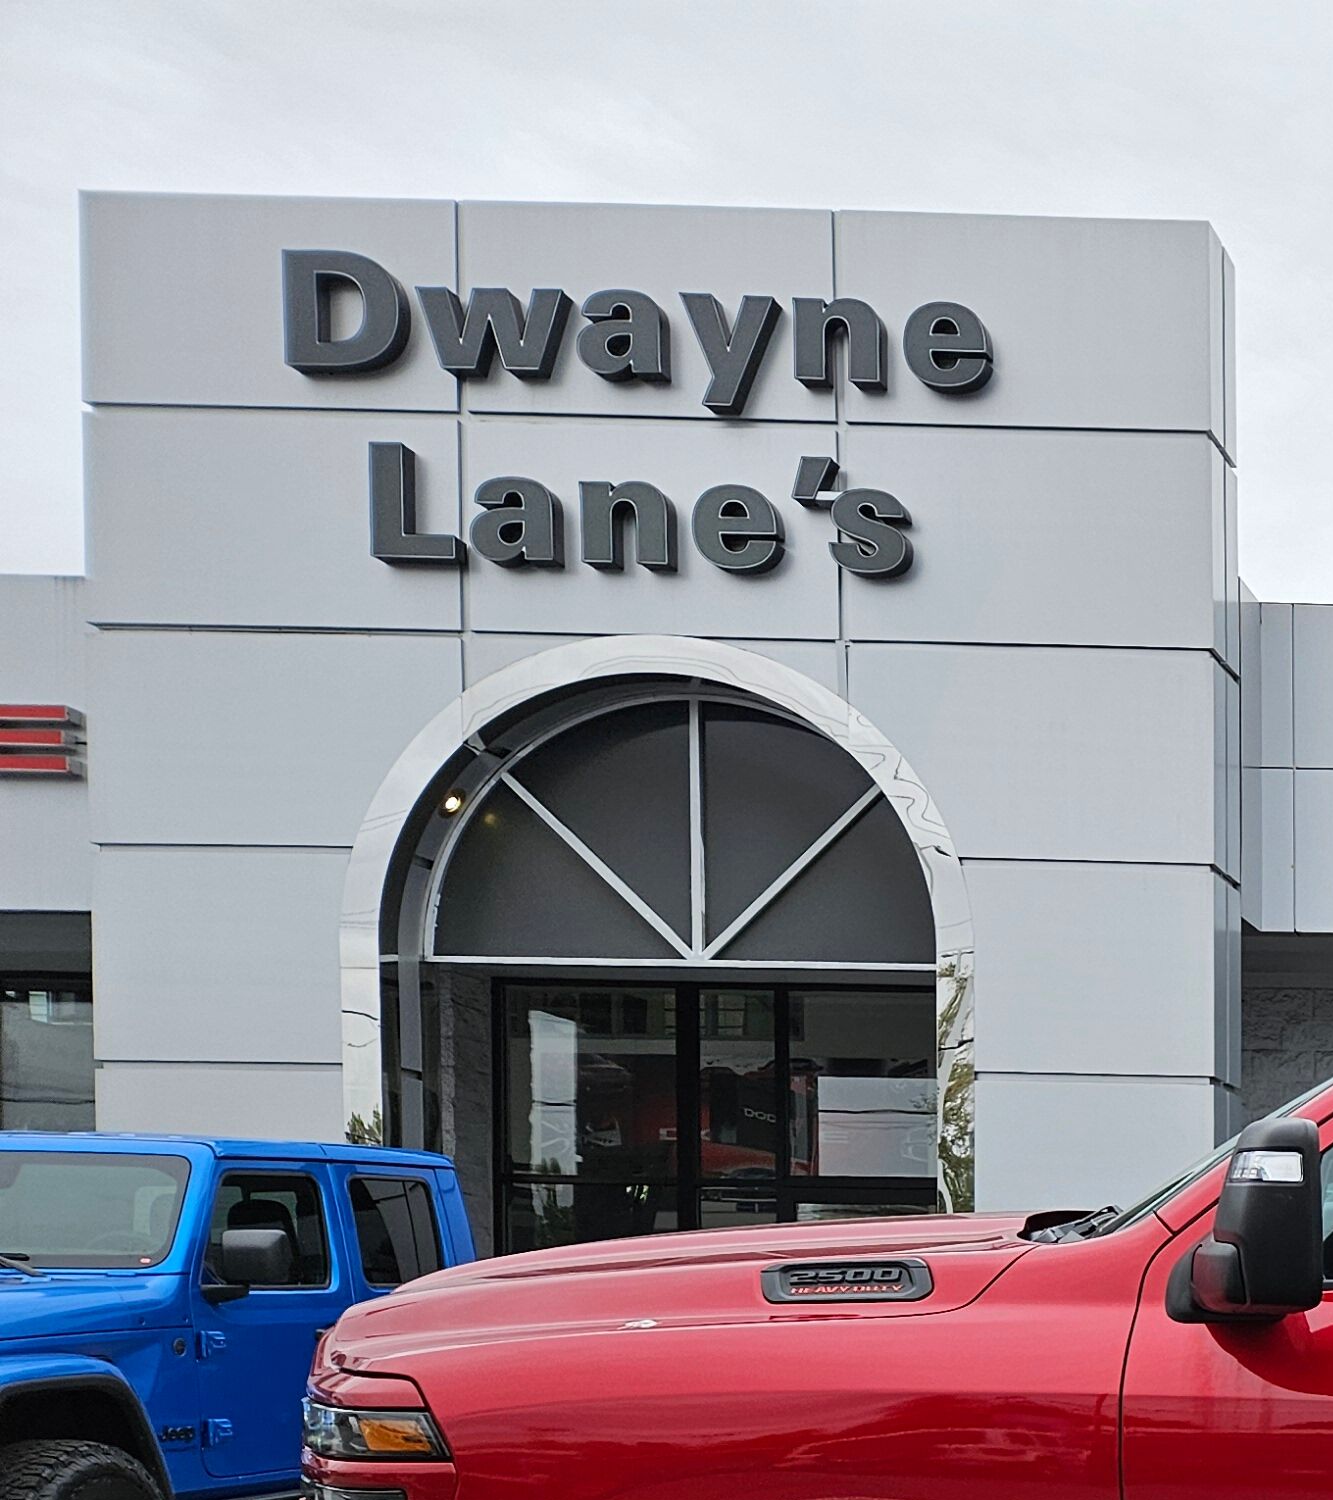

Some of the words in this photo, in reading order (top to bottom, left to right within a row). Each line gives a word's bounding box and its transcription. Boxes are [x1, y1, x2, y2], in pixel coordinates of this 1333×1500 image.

[282, 248, 993, 415] Dwayne
[368, 441, 913, 579] Lane's
[789, 1267, 902, 1286] 2500
[790, 1284, 850, 1295] HEAVY
[852, 1284, 903, 1293] DUTY
[157, 1424, 196, 1443] Jeep
